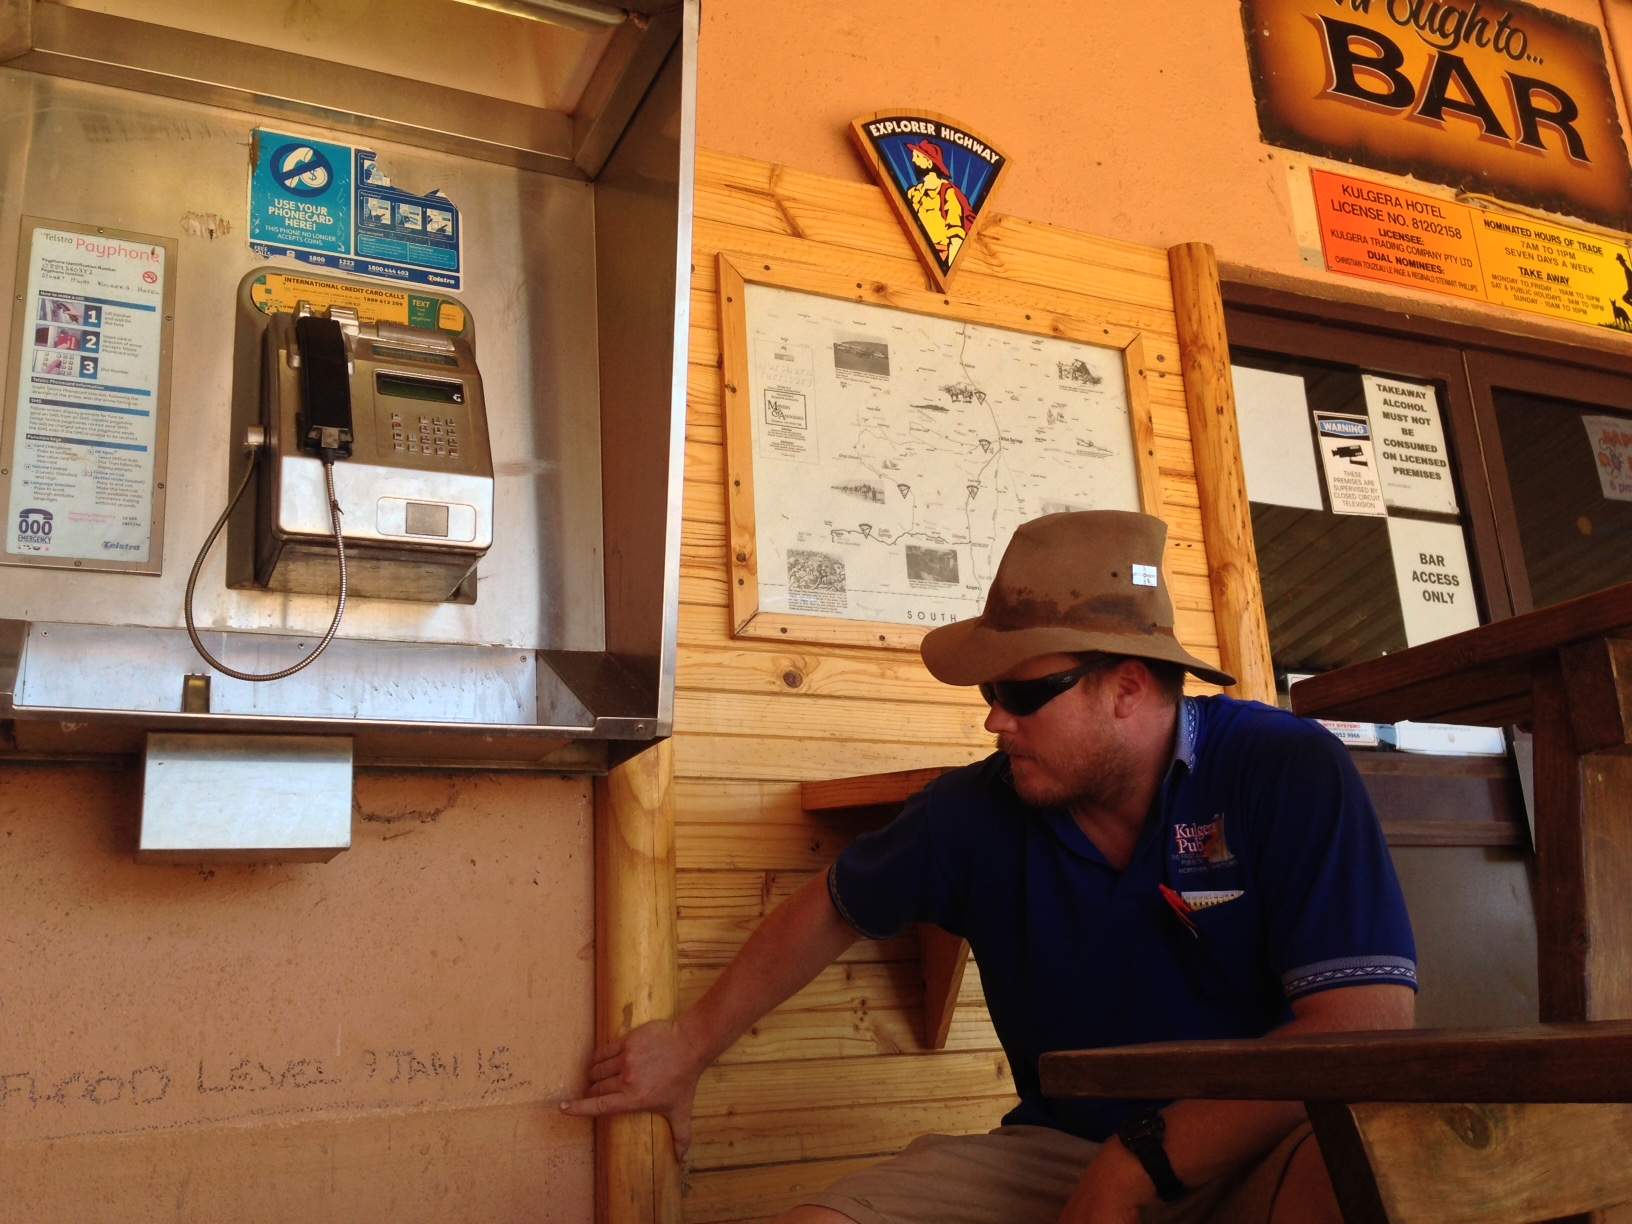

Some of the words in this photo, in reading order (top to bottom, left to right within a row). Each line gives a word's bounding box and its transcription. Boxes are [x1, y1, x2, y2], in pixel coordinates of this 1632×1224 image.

[1316, 13, 1592, 163] BAR
[869, 120, 936, 137] EXPLORER
[941, 126, 1000, 165] HIGHWAY
[274, 199, 295, 210] USE
[298, 202, 328, 216] YOUR
[1342, 184, 1403, 208] KULGERA
[1405, 202, 1446, 219] HOTEL
[268, 206, 333, 225] PHONECARD
[1331, 199, 1384, 221] LICENSE
[1388, 212, 1408, 227] NO.
[1412, 218, 1462, 240] 81202158
[285, 218, 316, 231] HERE!
[1378, 228, 1424, 246] LICENSEE:
[1484, 219, 1531, 237] NOMINATED
[1534, 232, 1561, 244] HOURS
[1564, 238, 1574, 247] OF
[1578, 242, 1603, 255] TRADE
[44, 233, 73, 244] Telstra
[76, 237, 160, 263] Payphone
[1330, 229, 1368, 245] KULGERA
[1370, 237, 1404, 252] TRADING
[1406, 244, 1442, 261] COMPANY
[1444, 254, 1457, 264] PTY
[1460, 257, 1472, 268] LTD
[1520, 241, 1539, 251] 7AM
[1542, 246, 1553, 254] TO
[1557, 249, 1576, 260] 11PM
[1368, 250, 1393, 263] DUAL
[1396, 256, 1444, 274] NOMINEES:
[1505, 247, 1534, 261] SEVEN
[1537, 255, 1558, 266] DAYS
[1562, 260, 1567, 268] A
[1570, 263, 1594, 274] WEEK
[1492, 274, 1518, 284] MONDAY
[1520, 279, 1529, 287] TO
[1518, 266, 1543, 280] TAKE
[1546, 273, 1569, 285] AWAY
[284, 276, 339, 290] INTERNATIONAL
[340, 285, 364, 294] CREDIT
[365, 288, 382, 296] CARD
[384, 291, 405, 300] CALLS
[412, 299, 430, 308] TEXT
[88, 310, 98, 323] 1
[86, 336, 96, 348] 2
[83, 361, 94, 373] 3
[1376, 384, 1426, 399] TAKEAWAY
[1383, 399, 1427, 412] ALCOHOL
[1382, 412, 1408, 423] MUST
[1411, 416, 1431, 426] NOT
[1324, 422, 1364, 434] WARNING
[1401, 428, 1415, 437] BE
[1383, 438, 1438, 453] CONSUMED
[1383, 452, 1397, 460] ON
[1399, 454, 1446, 468] LICENSED
[1344, 470, 1361, 478] THESE
[1393, 467, 1442, 480] PREMISES
[1333, 477, 1362, 486] PREMISES
[1363, 479, 1375, 487] ARE
[1333, 484, 1369, 494] SUPERVISED
[1333, 492, 1357, 500] CLOSED
[1343, 500, 1375, 509] TELEVISION
[18, 519, 52, 535] 000
[17, 534, 52, 545] EMERGENCY
[1419, 553, 1445, 567] BAR
[1412, 570, 1460, 586] ACCESS
[1422, 590, 1455, 604] ONLY
[907, 610, 957, 623] SOUTH
[1176, 838, 1203, 854] Pub
